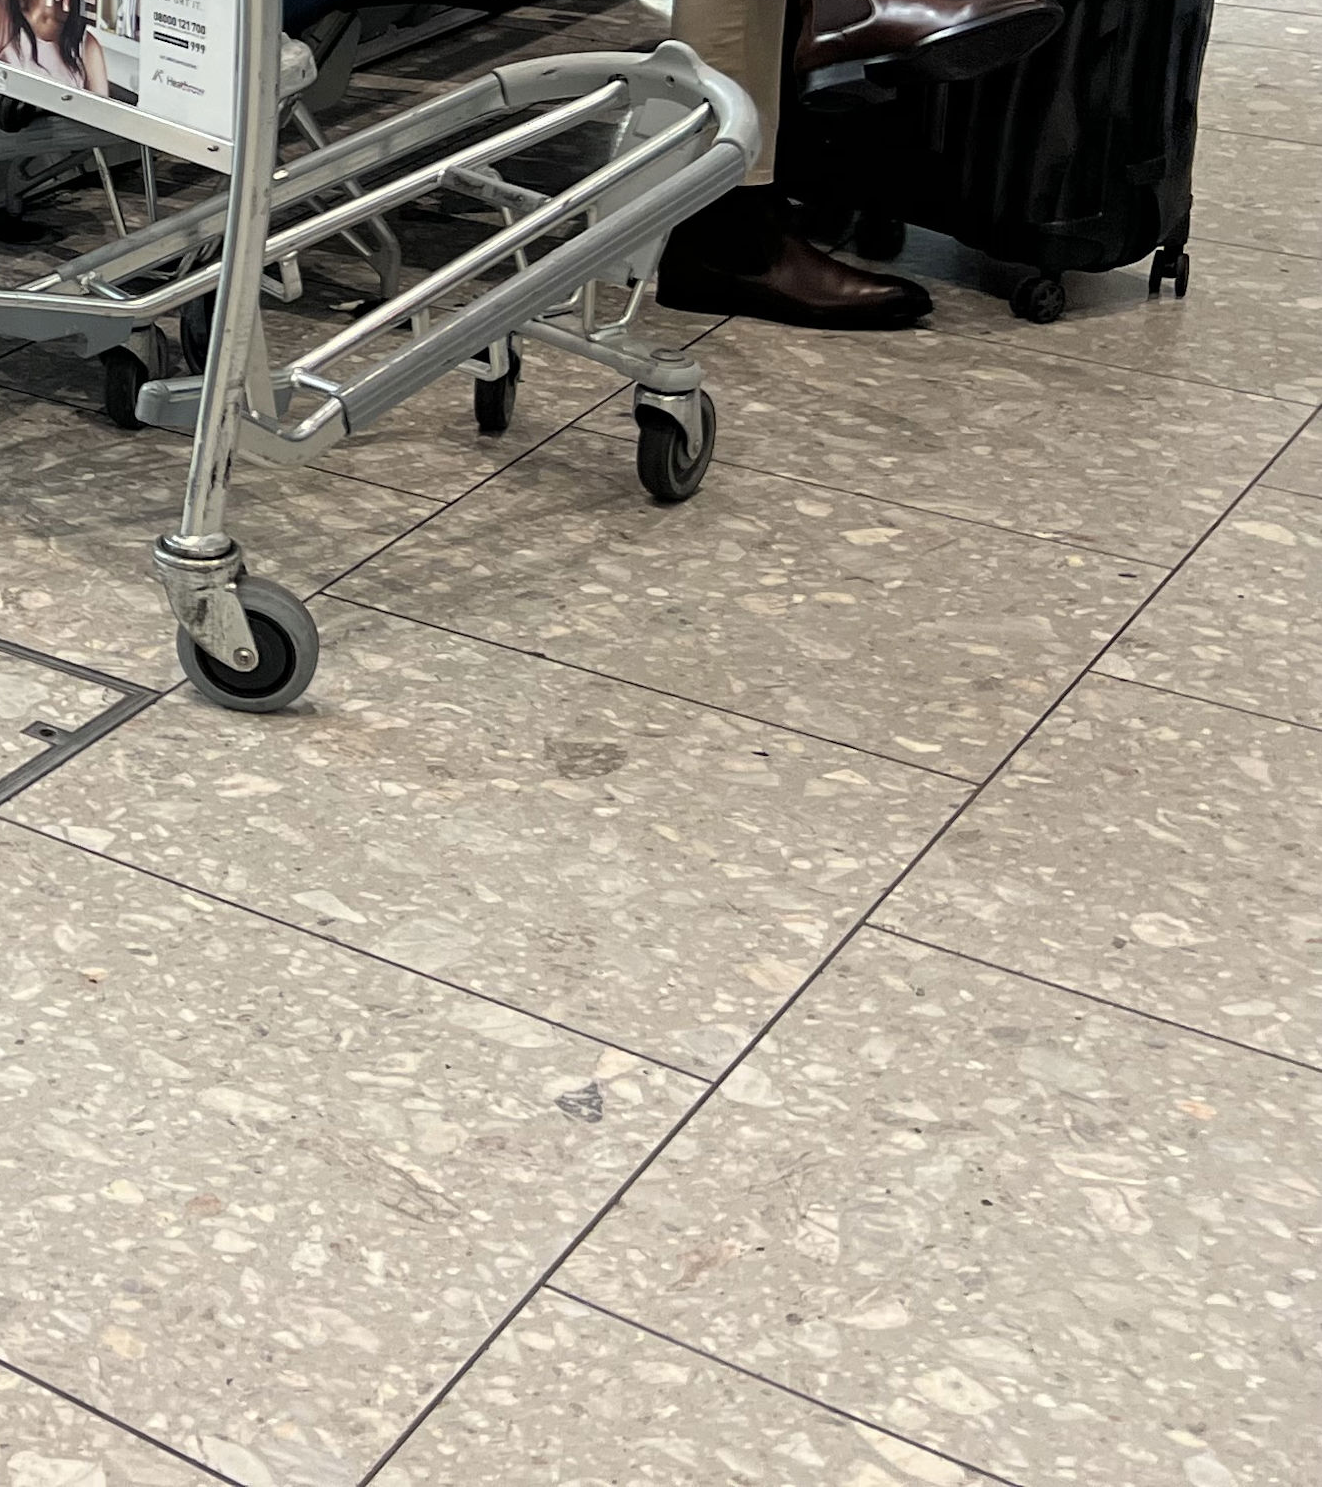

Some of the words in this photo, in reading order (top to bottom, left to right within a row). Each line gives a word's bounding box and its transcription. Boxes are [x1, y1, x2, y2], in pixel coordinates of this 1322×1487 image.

[153, 11, 177, 26] 08000
[178, 18, 190, 30] 121
[192, 22, 206, 35] 700
[190, 41, 206, 54] 999
